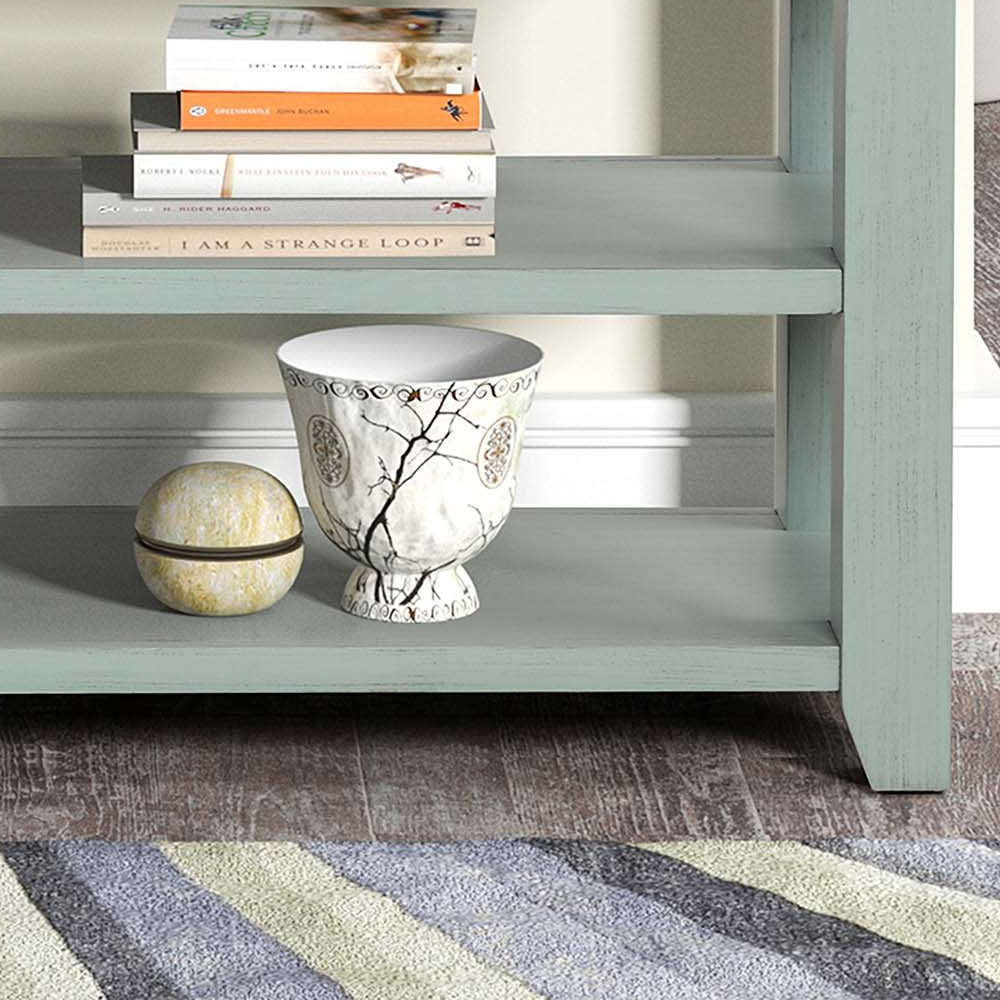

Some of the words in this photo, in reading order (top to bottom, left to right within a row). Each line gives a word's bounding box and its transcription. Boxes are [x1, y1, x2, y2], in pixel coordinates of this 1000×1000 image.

[214, 107, 271, 115] GREENMANTLE
[181, 240, 188, 250] I
[197, 240, 231, 250] AM
[240, 240, 255, 250] A
[263, 238, 370, 250] STRANGE
[380, 237, 445, 249] LOOP
